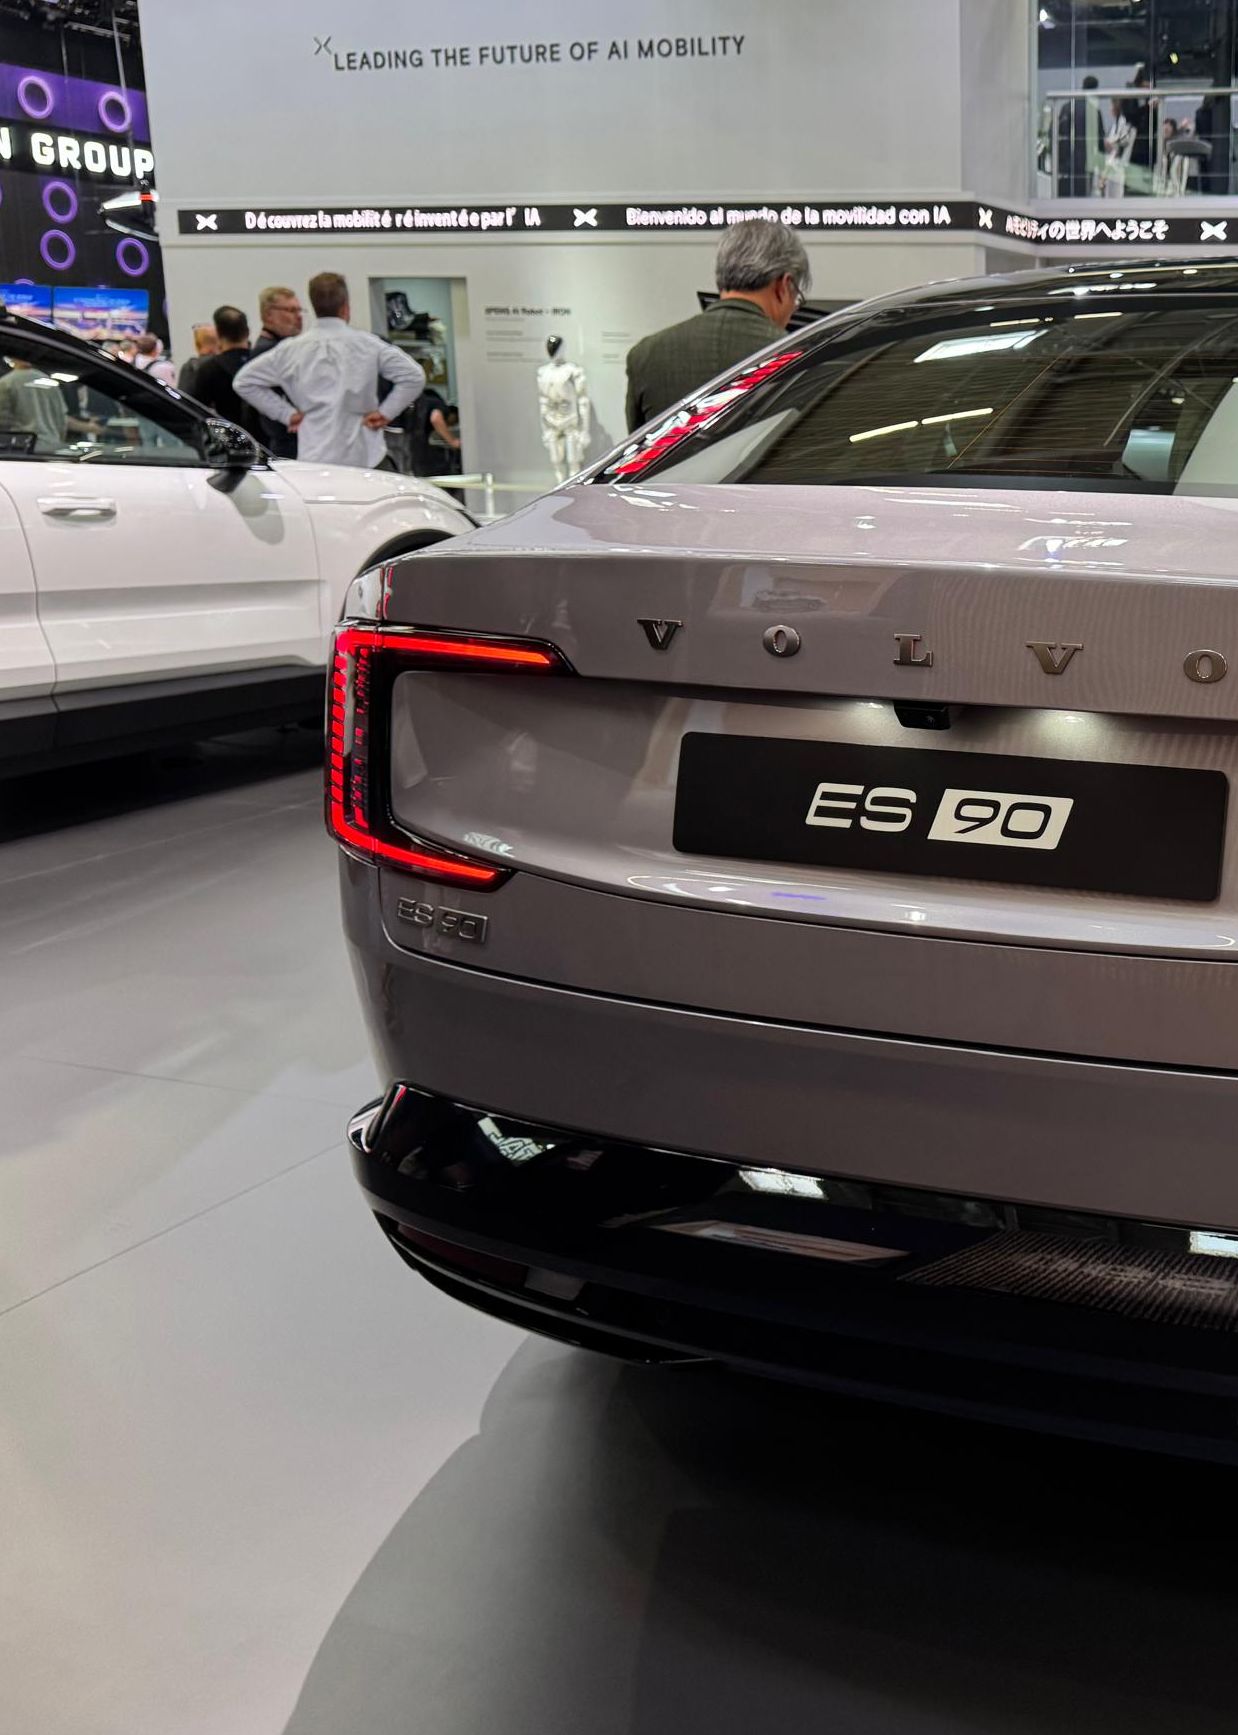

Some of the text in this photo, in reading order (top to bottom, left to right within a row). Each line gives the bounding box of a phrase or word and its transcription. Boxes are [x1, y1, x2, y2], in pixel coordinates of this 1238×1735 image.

[334, 34, 745, 71] LEADING THE FUTURE OF AI MOBILITY
[30, 132, 155, 180] GROUP
[318, 209, 333, 229] la
[480, 210, 505, 231] par
[625, 206, 708, 226] Bienvenido
[709, 205, 725, 226] al
[780, 205, 802, 226] de
[804, 205, 820, 226] la
[822, 205, 897, 226] movilidad
[899, 208, 931, 225] con
[933, 205, 952, 225] IA
[637, 618, 1229, 684] VOLVO
[804, 782, 1033, 841] ES 90
[398, 896, 435, 927] ES
